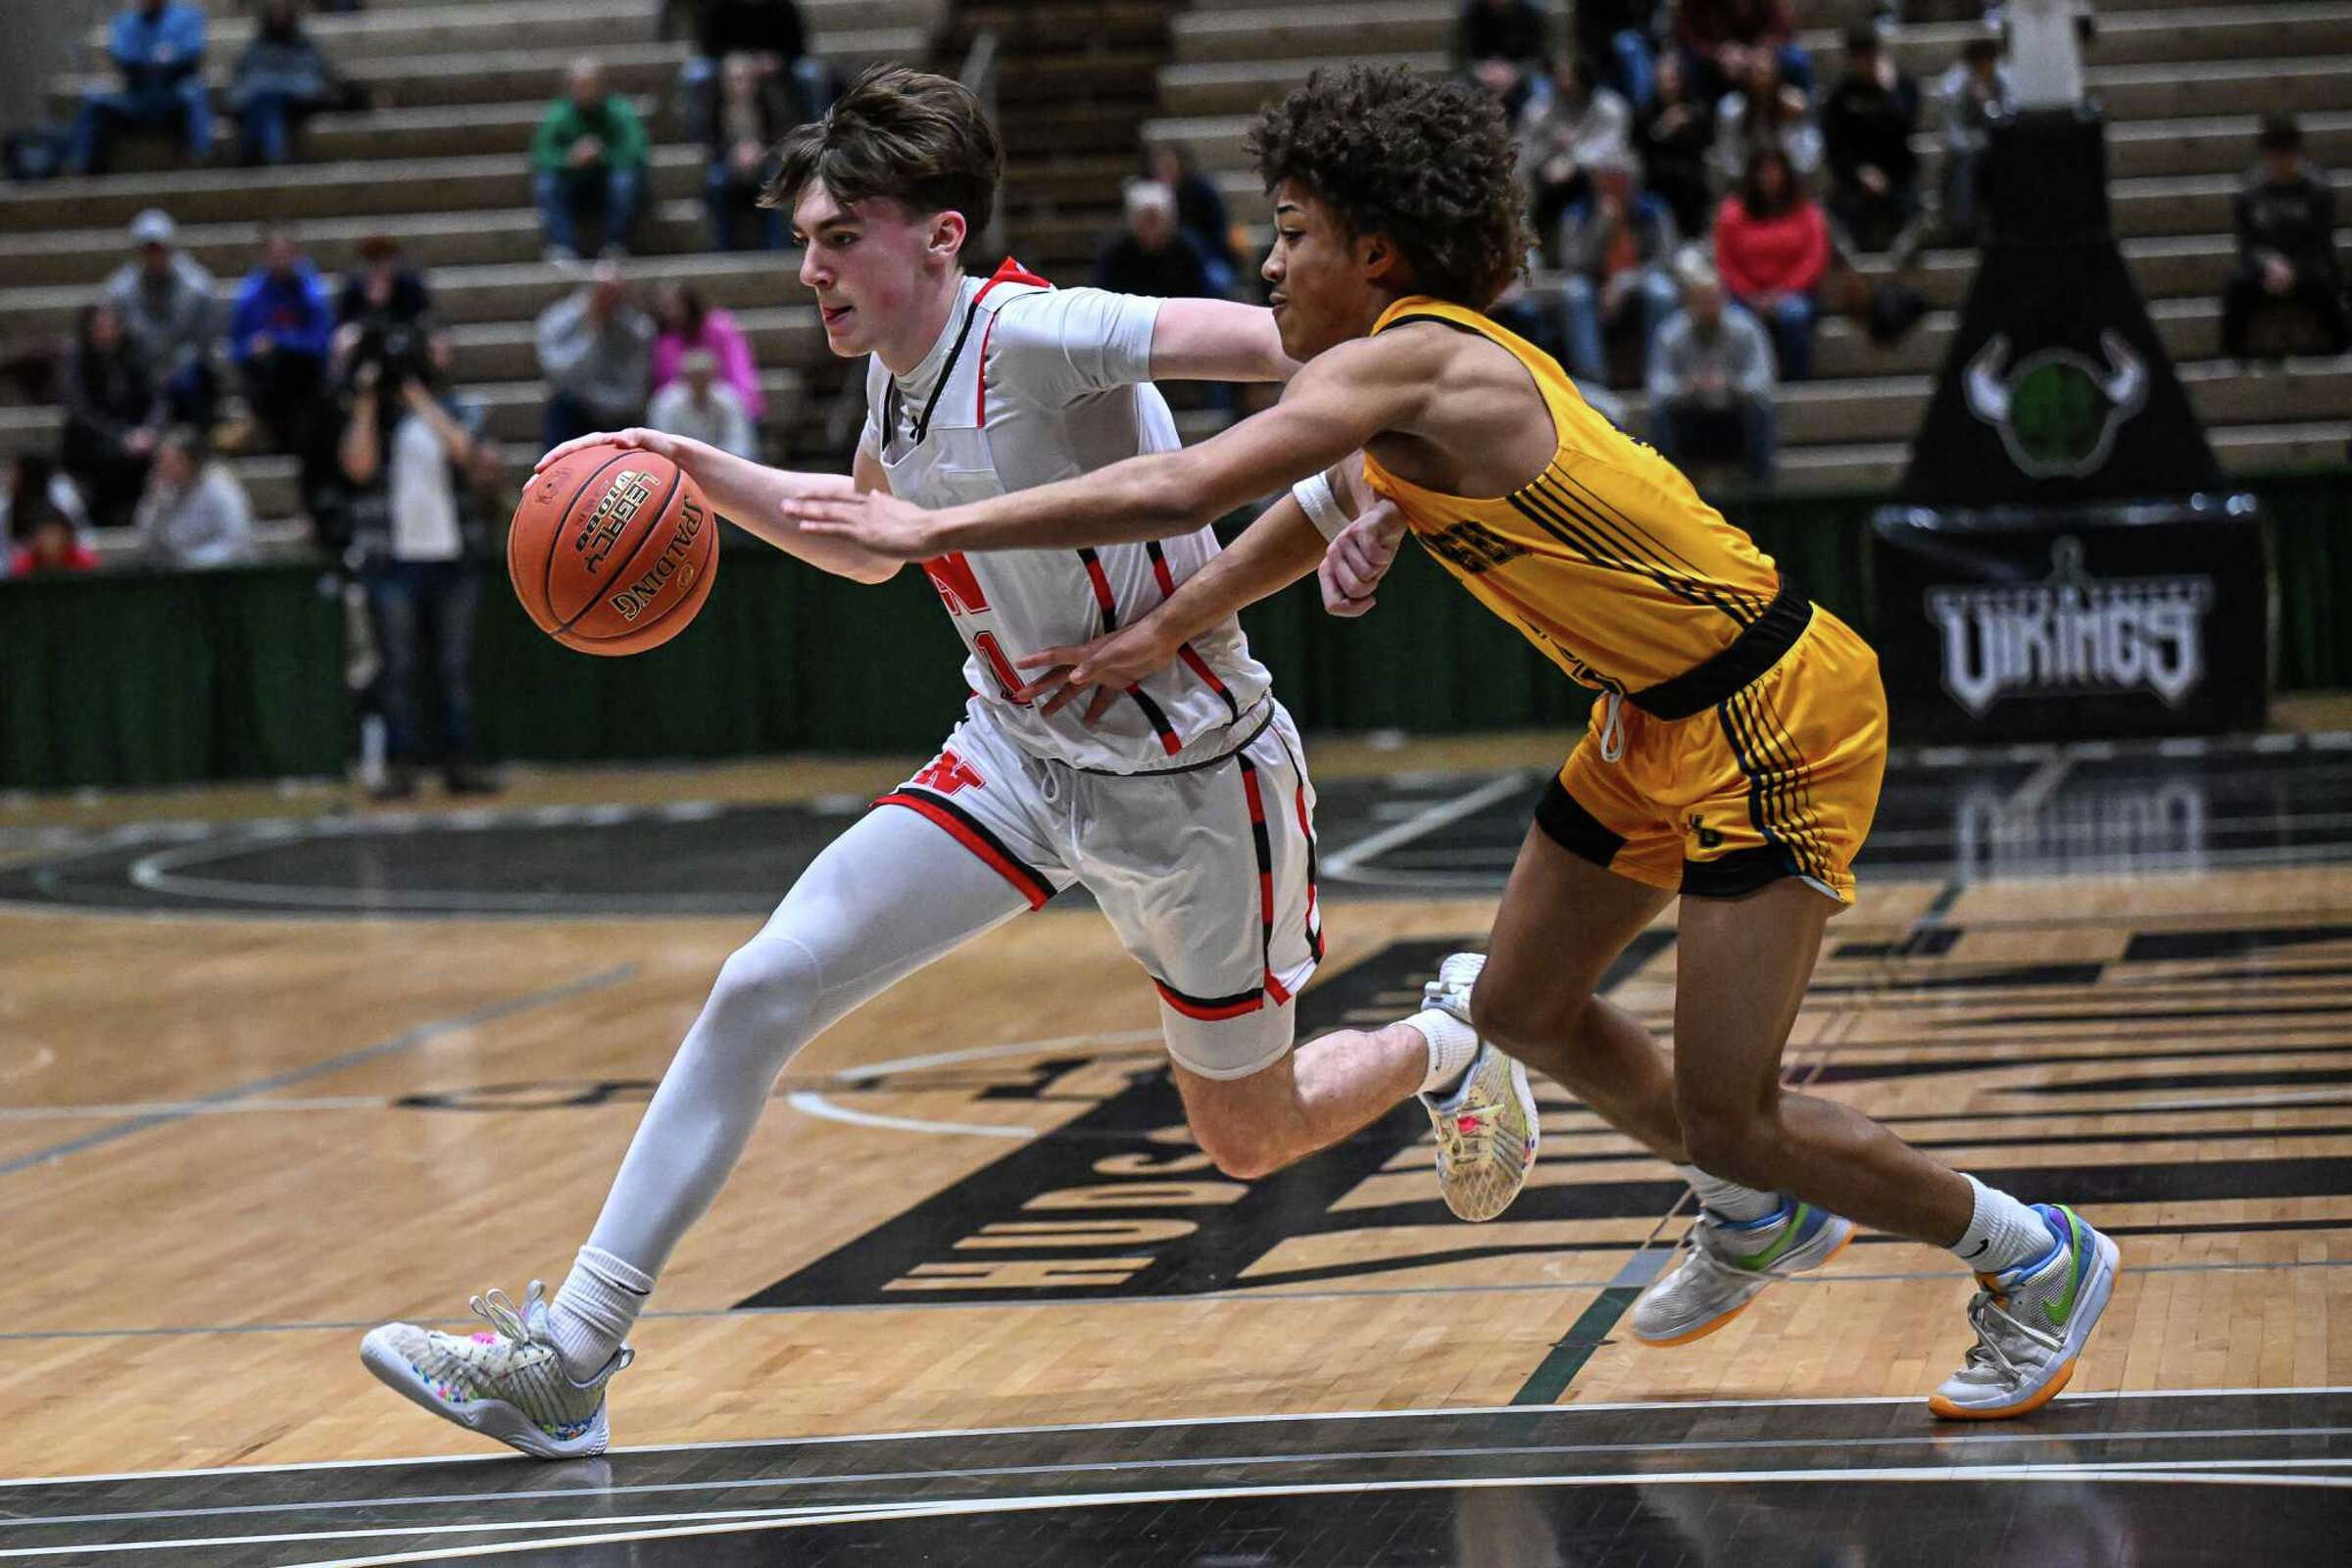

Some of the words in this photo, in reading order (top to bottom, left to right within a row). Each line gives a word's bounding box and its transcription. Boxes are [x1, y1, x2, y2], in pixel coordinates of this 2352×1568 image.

[584, 470, 661, 574] LEGACY
[610, 493, 705, 621] SPALDING
[1928, 576, 2212, 718] VIKINGS
